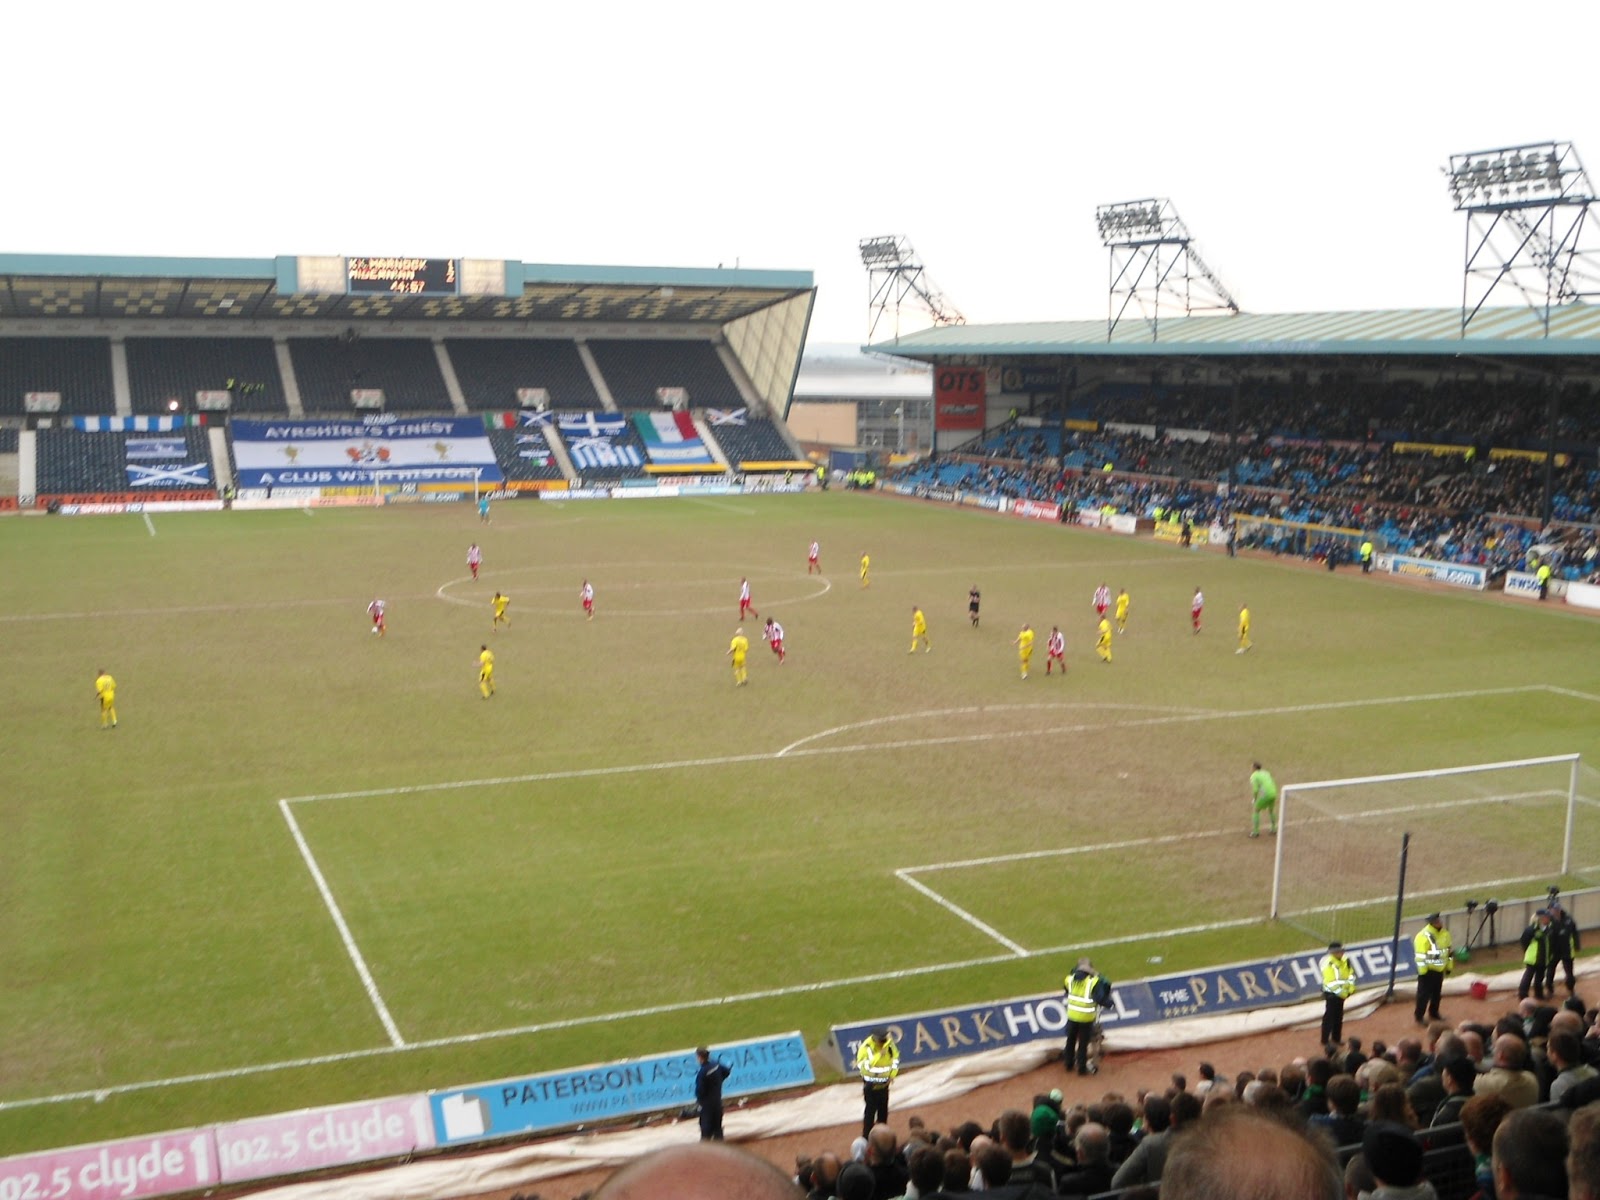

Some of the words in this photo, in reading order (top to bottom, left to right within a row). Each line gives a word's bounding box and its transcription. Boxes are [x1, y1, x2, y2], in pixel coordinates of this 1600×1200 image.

[265, 424, 383, 438] AYRSHIRE'S
[385, 421, 455, 436] FINEST
[260, 472, 275, 484] A
[278, 471, 333, 483] CLUB
[1158, 987, 1190, 1005] THE
[1187, 964, 1296, 1007] PARK
[1290, 944, 1410, 989] HTEL
[1003, 989, 1140, 1038] HOL
[502, 1067, 643, 1108] PATERSON
[652, 1041, 804, 1084] ASSCIATES
[220, 1130, 301, 1167] 102.5
[306, 1105, 405, 1156] clyde
[410, 1095, 430, 1145] 1
[79, 1140, 186, 1197] clyde
[190, 1133, 210, 1183] 1
